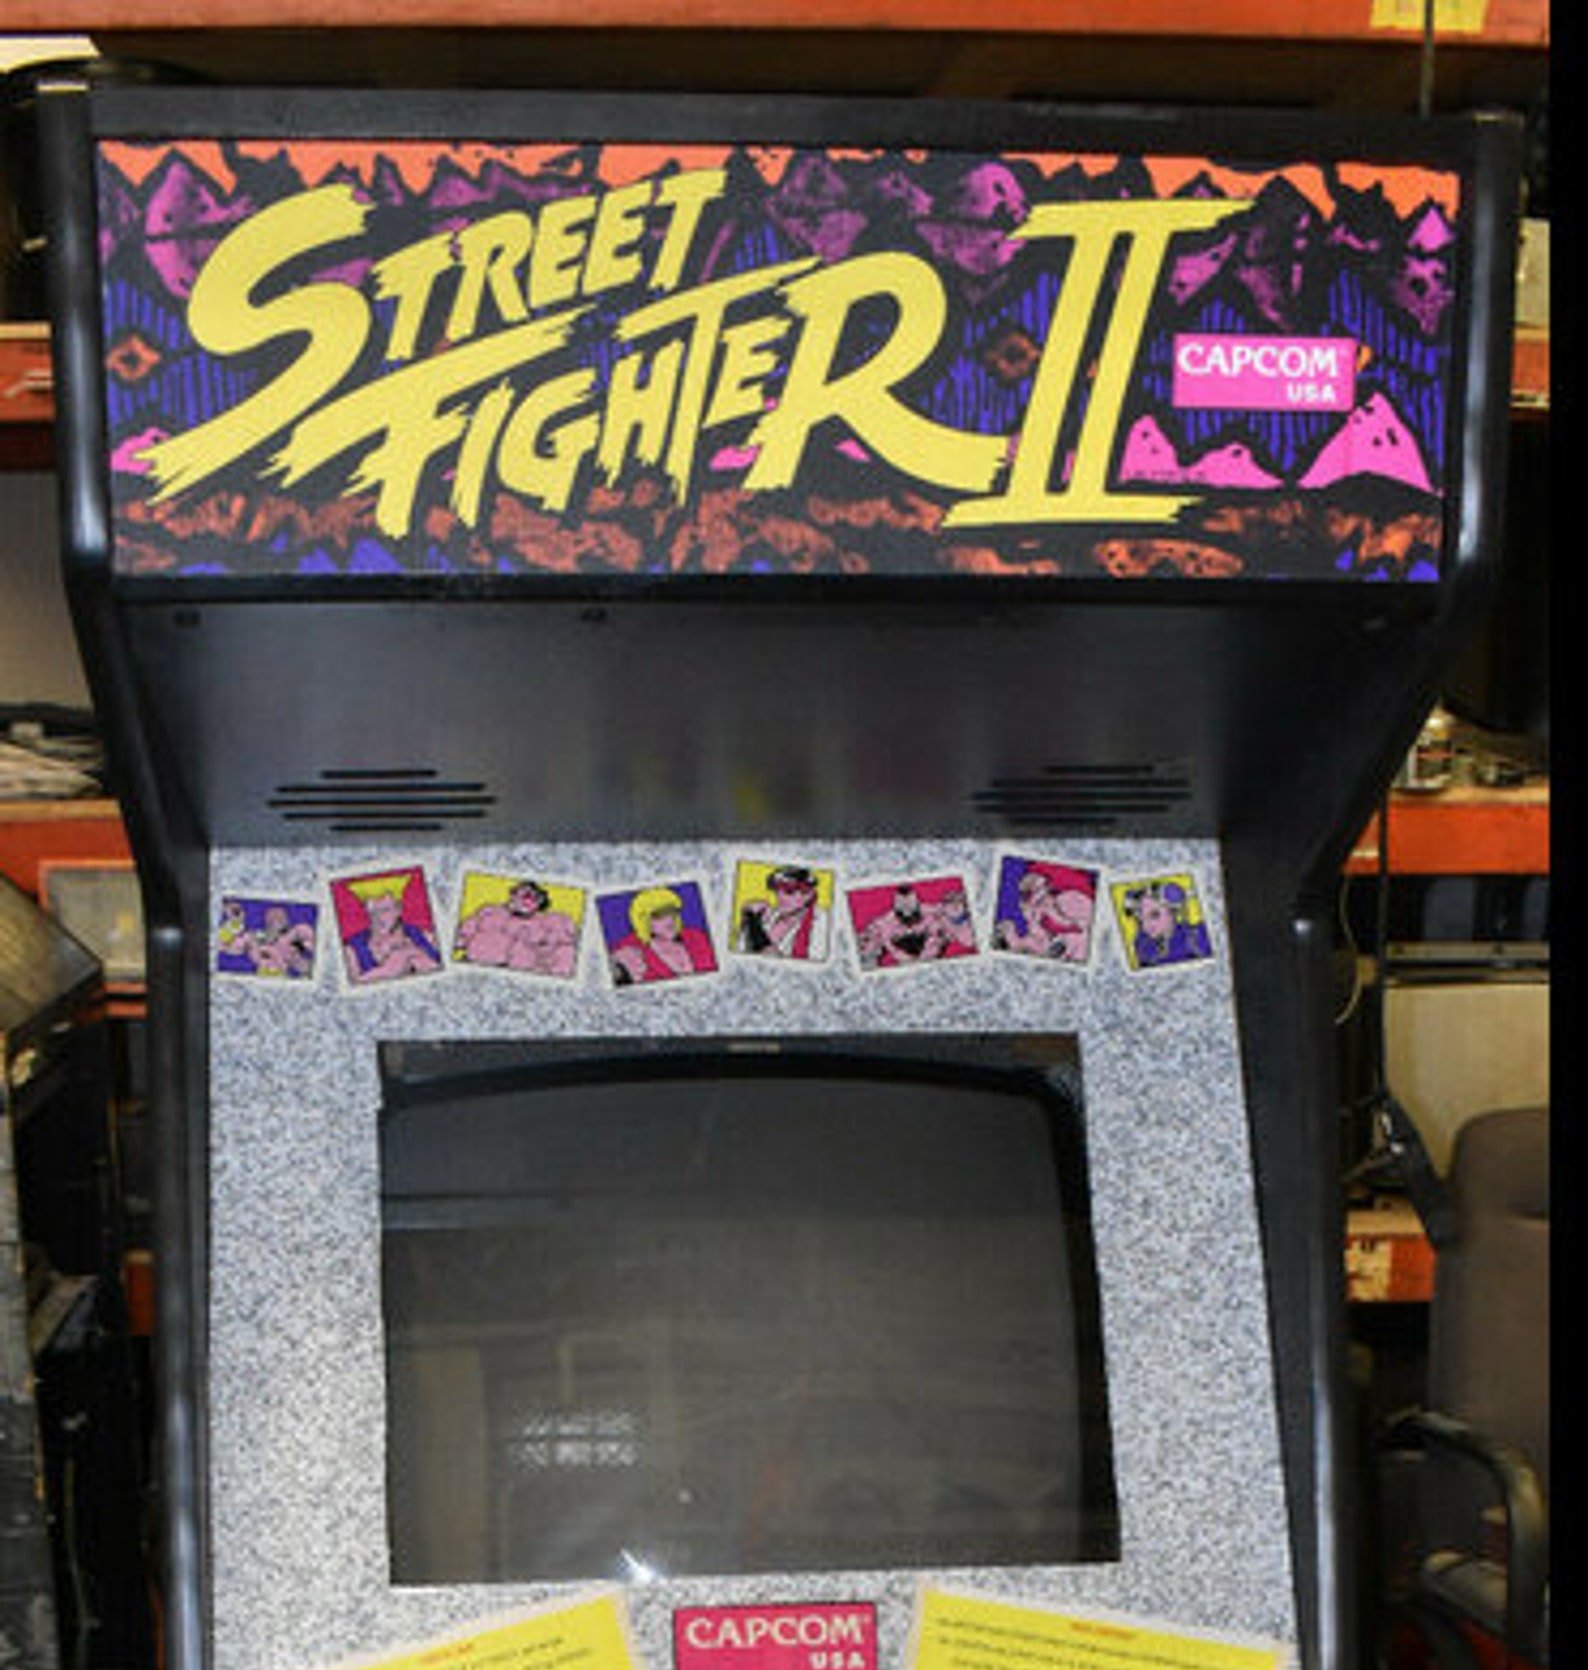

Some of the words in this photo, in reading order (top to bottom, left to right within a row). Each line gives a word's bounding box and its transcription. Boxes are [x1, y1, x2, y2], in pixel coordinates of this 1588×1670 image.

[134, 168, 728, 506] STREET
[258, 250, 1010, 541] FIGHTER
[941, 198, 1258, 527] II
[1176, 342, 1339, 378] CAPCOM
[1286, 383, 1337, 403] USA
[685, 1613, 864, 1650] CAPCOM
[809, 1651, 866, 1670] USA
